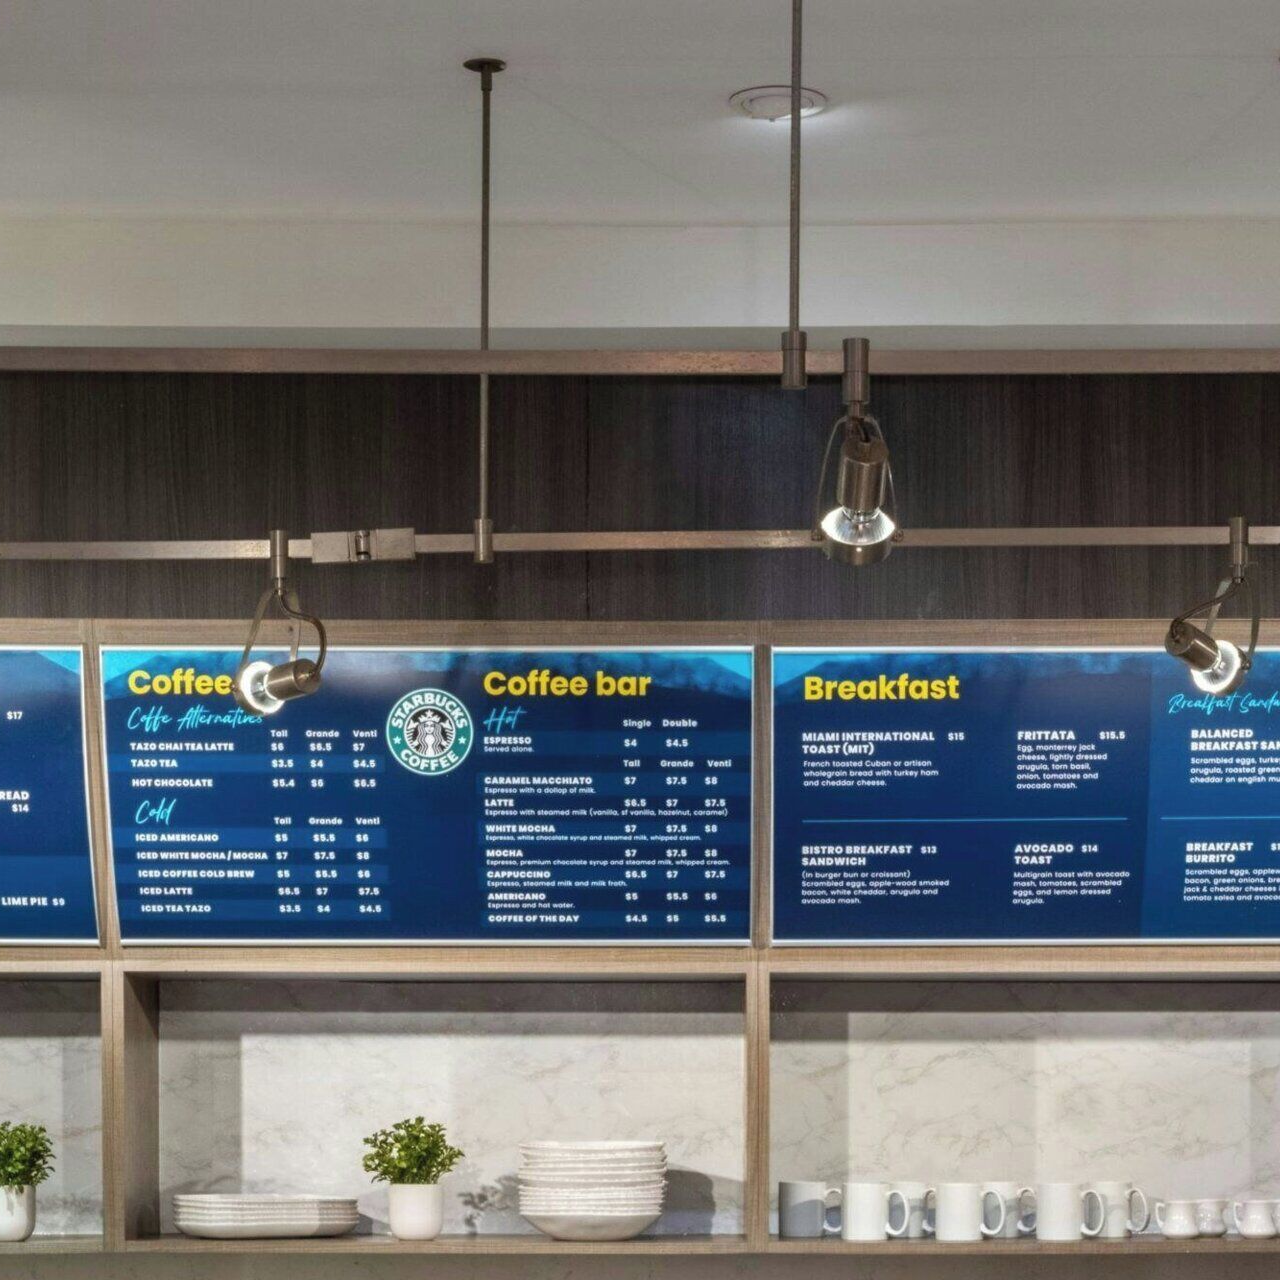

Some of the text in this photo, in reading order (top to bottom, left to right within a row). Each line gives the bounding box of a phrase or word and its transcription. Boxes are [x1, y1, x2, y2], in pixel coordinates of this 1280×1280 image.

[128, 668, 232, 695] Coffee
[483, 670, 652, 696] Coffee bar
[804, 673, 960, 700] Breakfast
[1169, 692, 1239, 714] Breakfast
[7, 710, 22, 721] $17
[391, 692, 468, 728] STARBUCKS
[483, 706, 527, 733] Hot
[623, 718, 697, 730] Single Double
[270, 729, 377, 739] Tall Grande Venti
[802, 731, 964, 743] MIAMI INTERNATIONAL $15
[1018, 729, 1125, 741] FRITTATA $15.5
[1191, 728, 1253, 739] BALANCED
[130, 742, 234, 752] TAZO CHAI TEA LATTE
[484, 735, 688, 748] ESPRESSO $4 $4.5
[1191, 740, 1258, 751] BREAKFAST
[802, 742, 874, 756] TOAST (MIT)
[401, 749, 459, 770] COFFEE
[623, 759, 731, 769] Tall Grande Venti
[484, 776, 531, 786] CARAMEL
[532, 776, 592, 786] MACCHIATO
[624, 775, 636, 786] $7
[666, 775, 687, 786] $7.5
[12, 803, 29, 813] $14
[135, 798, 177, 825] Cold
[1015, 843, 1098, 854] AVOCADO $14
[1186, 841, 1253, 852] BREAKFAST
[1014, 855, 1052, 865] TOAST
[1186, 853, 1235, 864] BURRITO
[1, 896, 28, 907] LIME
[30, 896, 48, 907] PIE
[488, 892, 546, 901] AMERICANO
